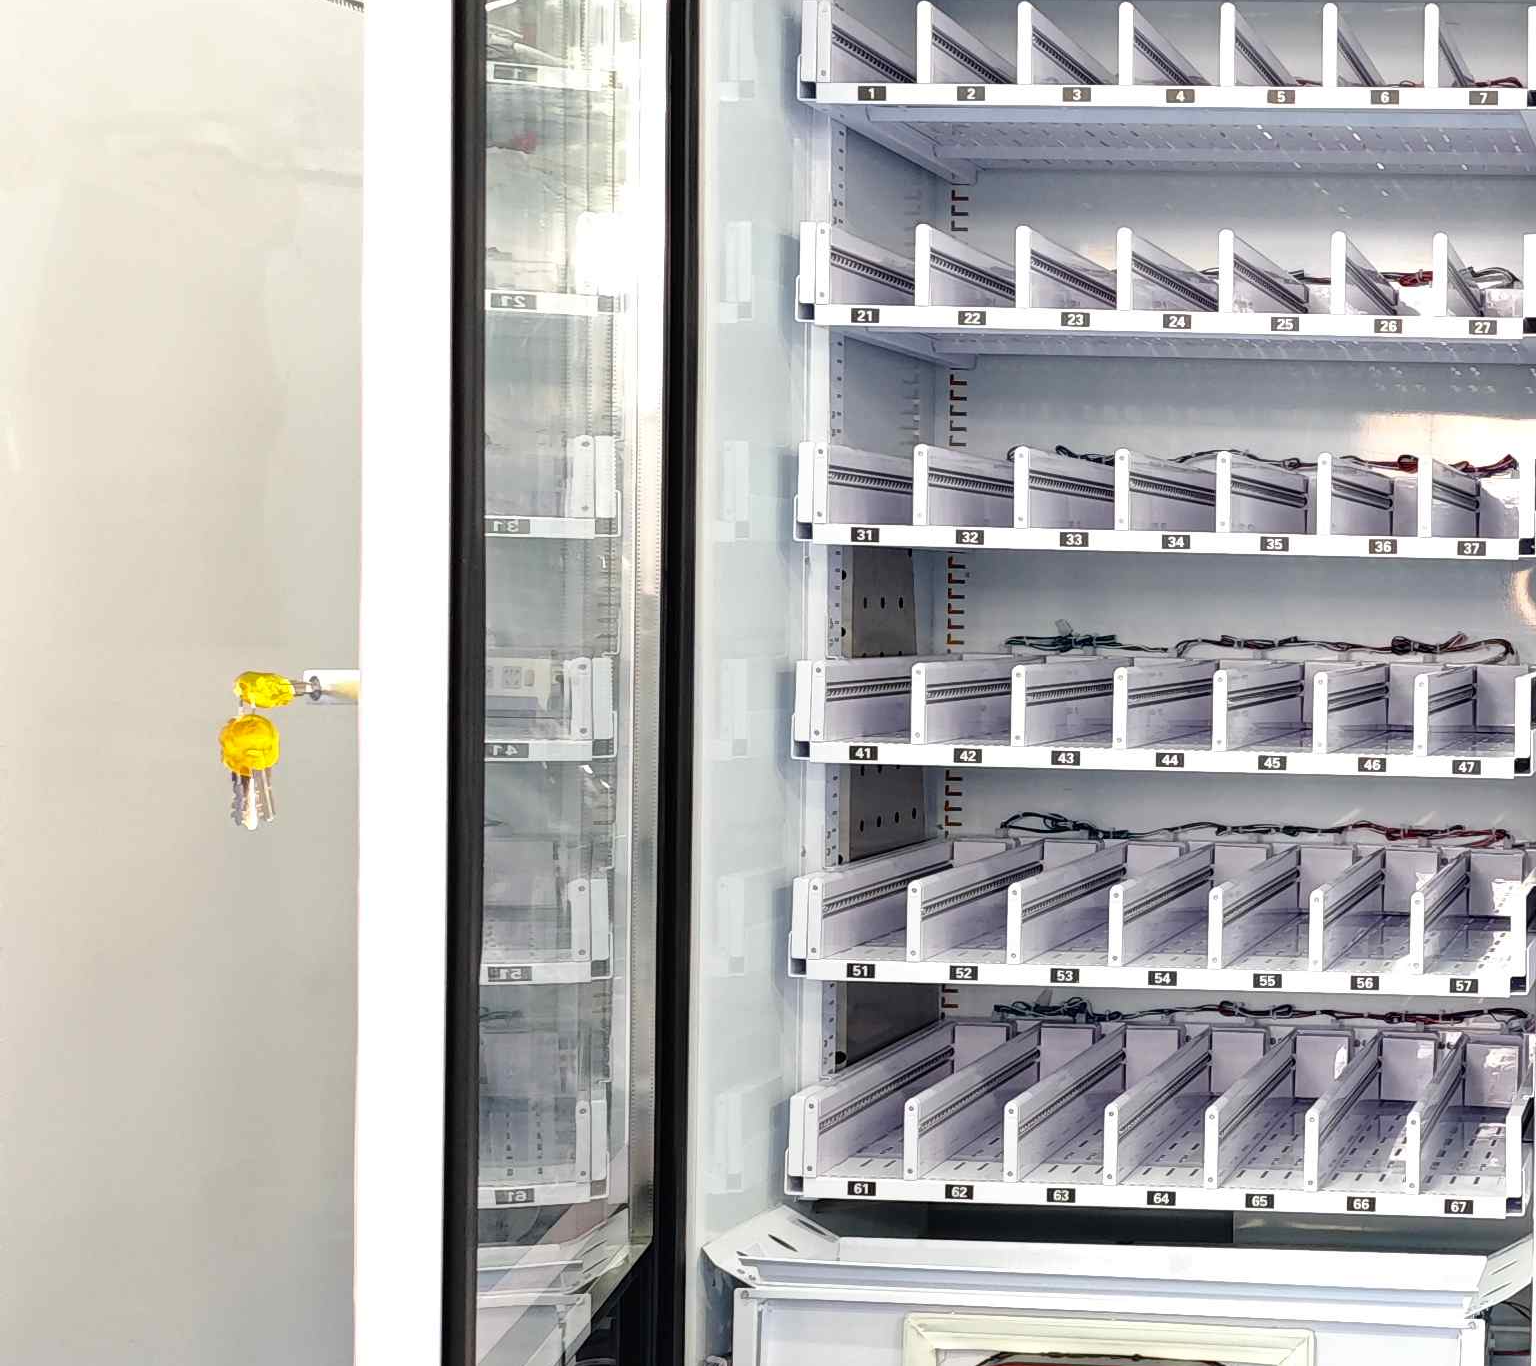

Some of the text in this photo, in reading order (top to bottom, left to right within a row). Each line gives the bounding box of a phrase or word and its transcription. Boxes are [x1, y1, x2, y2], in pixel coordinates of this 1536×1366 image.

[868, 87, 1488, 104] 1 2 3 4 5 6 7
[856, 309, 1491, 334] 21 22 23 24 25 26 27
[856, 529, 1480, 555] 31 32 33 34 35 36 37
[855, 747, 1475, 773] 41 42 43 44 45 46 47
[852, 965, 1472, 992] 51 52 53 54 55 56 57
[853, 1182, 1467, 1213] 61 62 63 64 65 66 67
